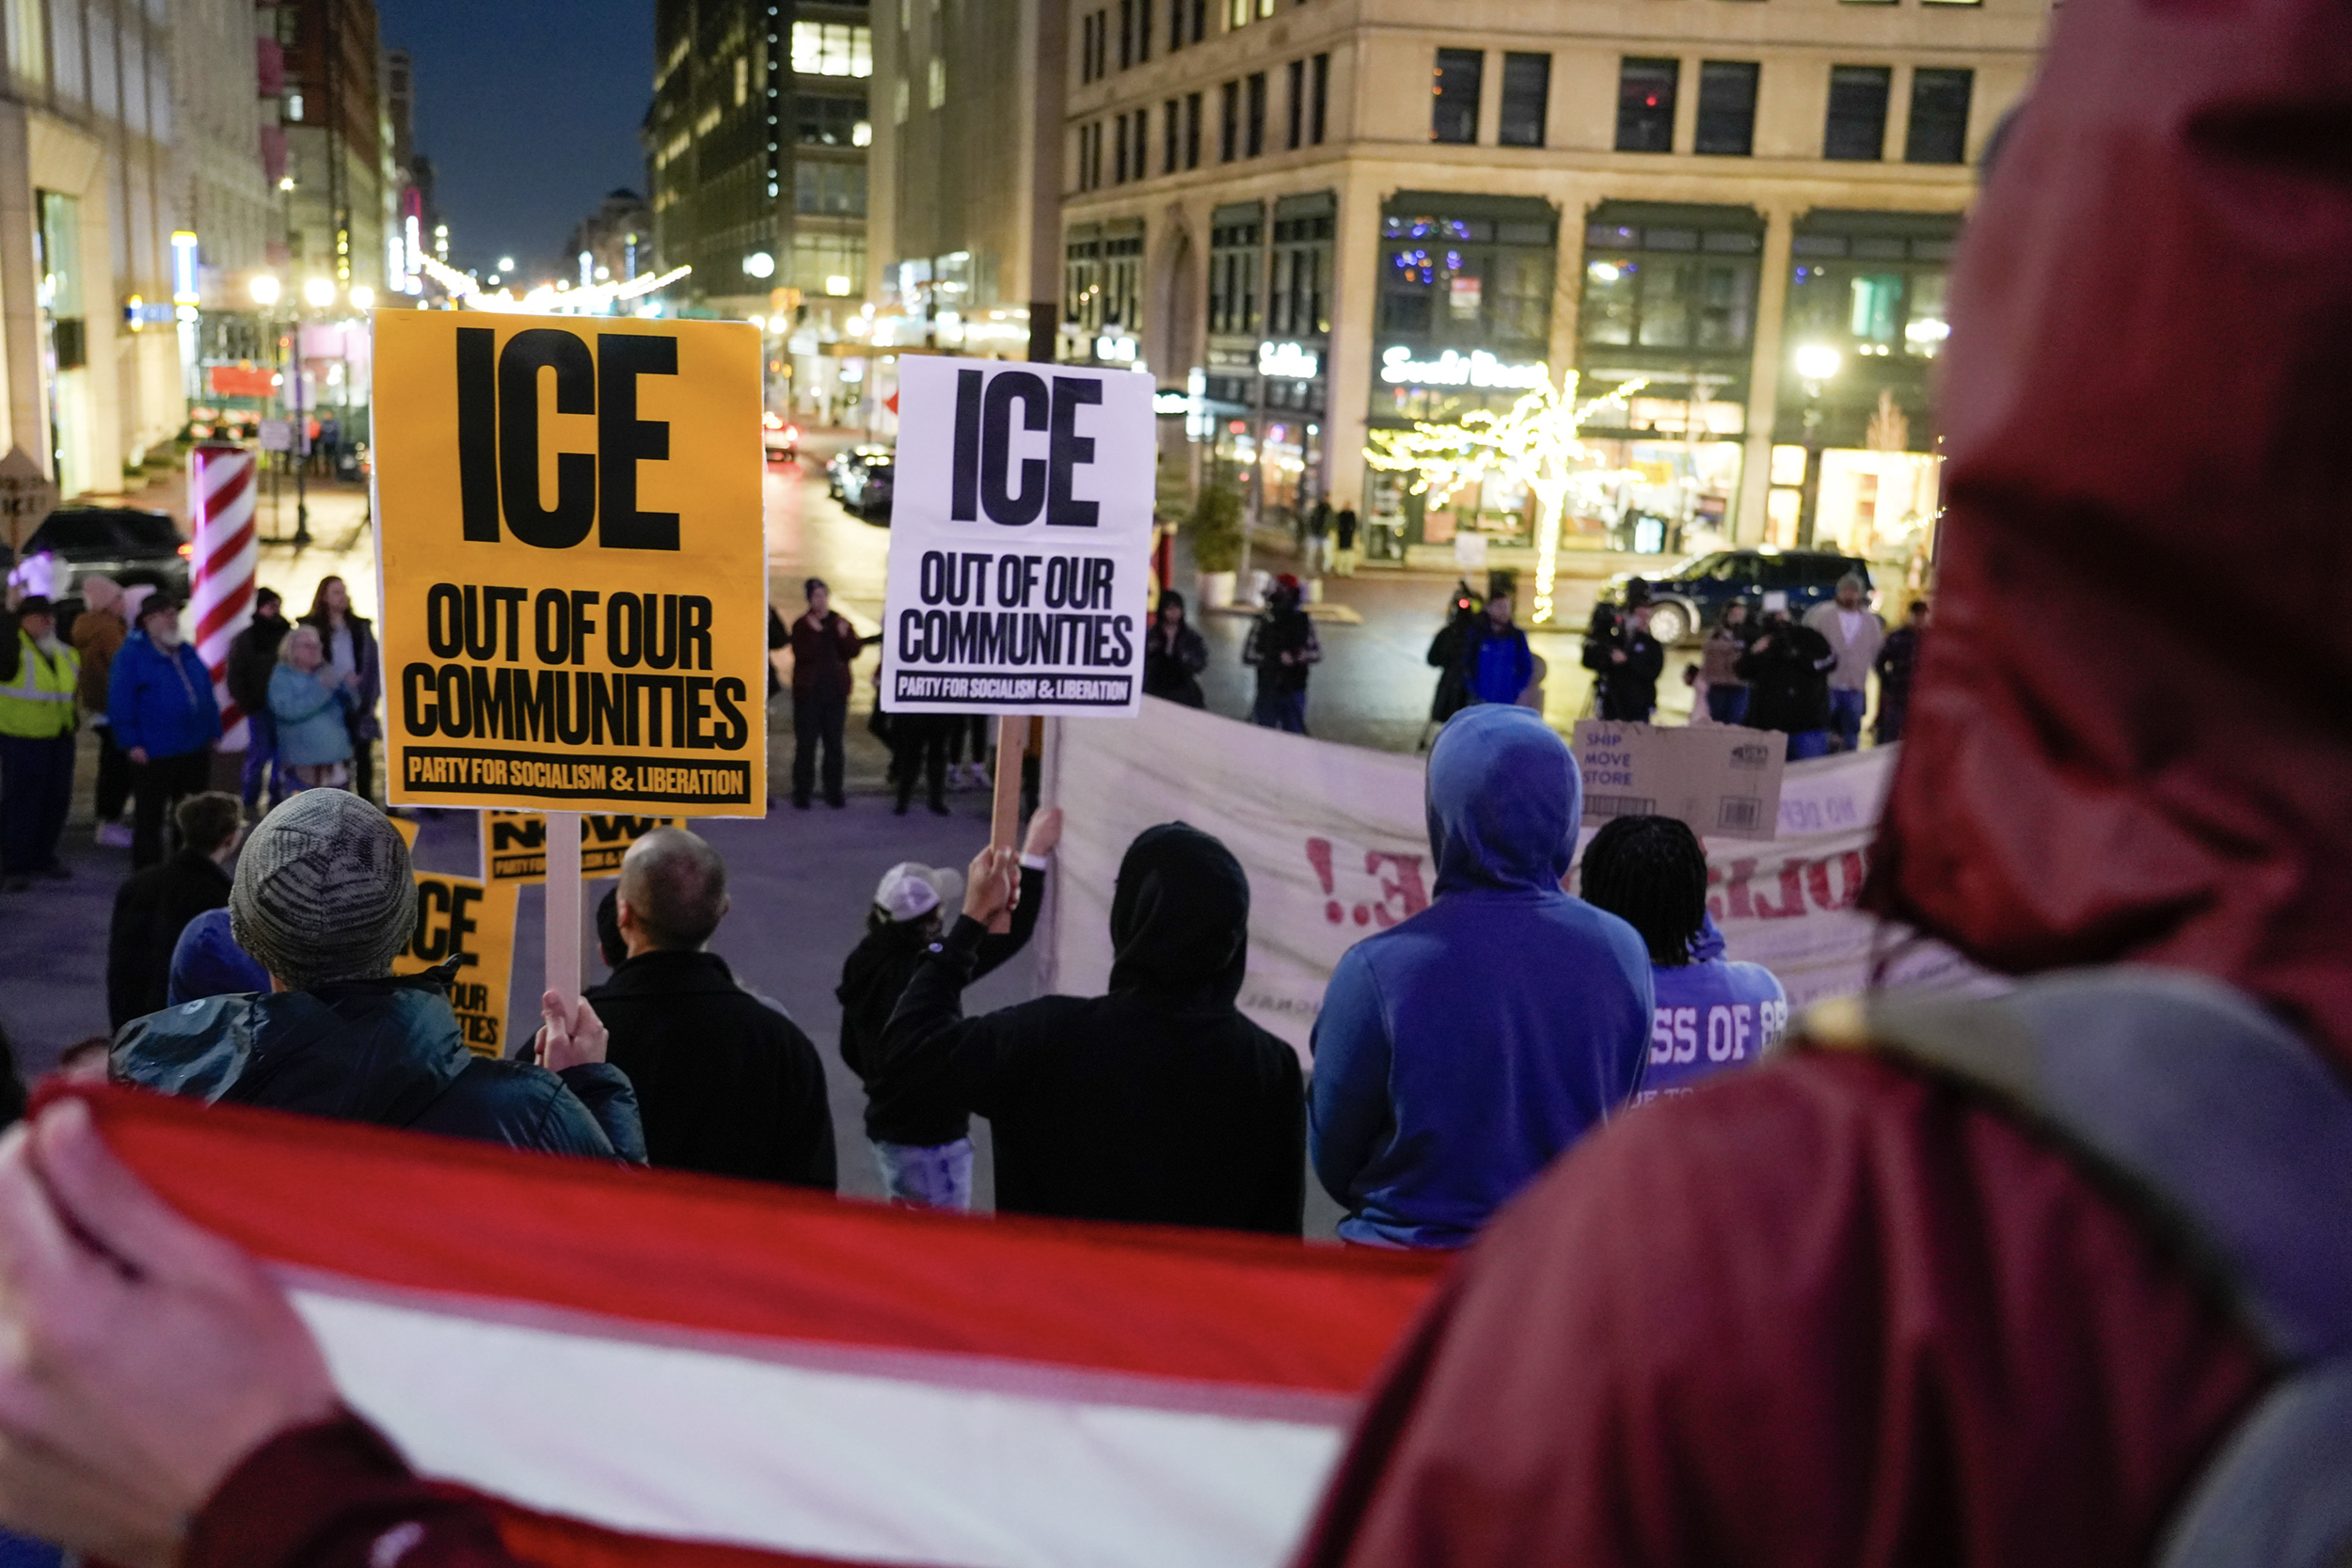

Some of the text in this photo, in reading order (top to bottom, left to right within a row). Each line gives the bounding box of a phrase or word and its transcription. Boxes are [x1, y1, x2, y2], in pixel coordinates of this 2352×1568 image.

[456, 327, 680, 551] ICE
[951, 369, 1103, 528] ICE
[920, 550, 1115, 610] OUT OF OUR
[427, 582, 713, 671] OUT OF OUR
[898, 609, 1134, 668] COMMUNITIES
[402, 661, 749, 752] COMMUNITIES
[898, 676, 1129, 702] PARTY FOR SOCIALISM & LIBERATION
[1584, 752, 1630, 768] MOVE
[1586, 733, 1622, 748] SHIP
[408, 756, 744, 796] PARTY FOR SOCIALISM & LIBERATION
[1583, 769, 1631, 786] STORE
[1708, 1004, 1751, 1062] OF
